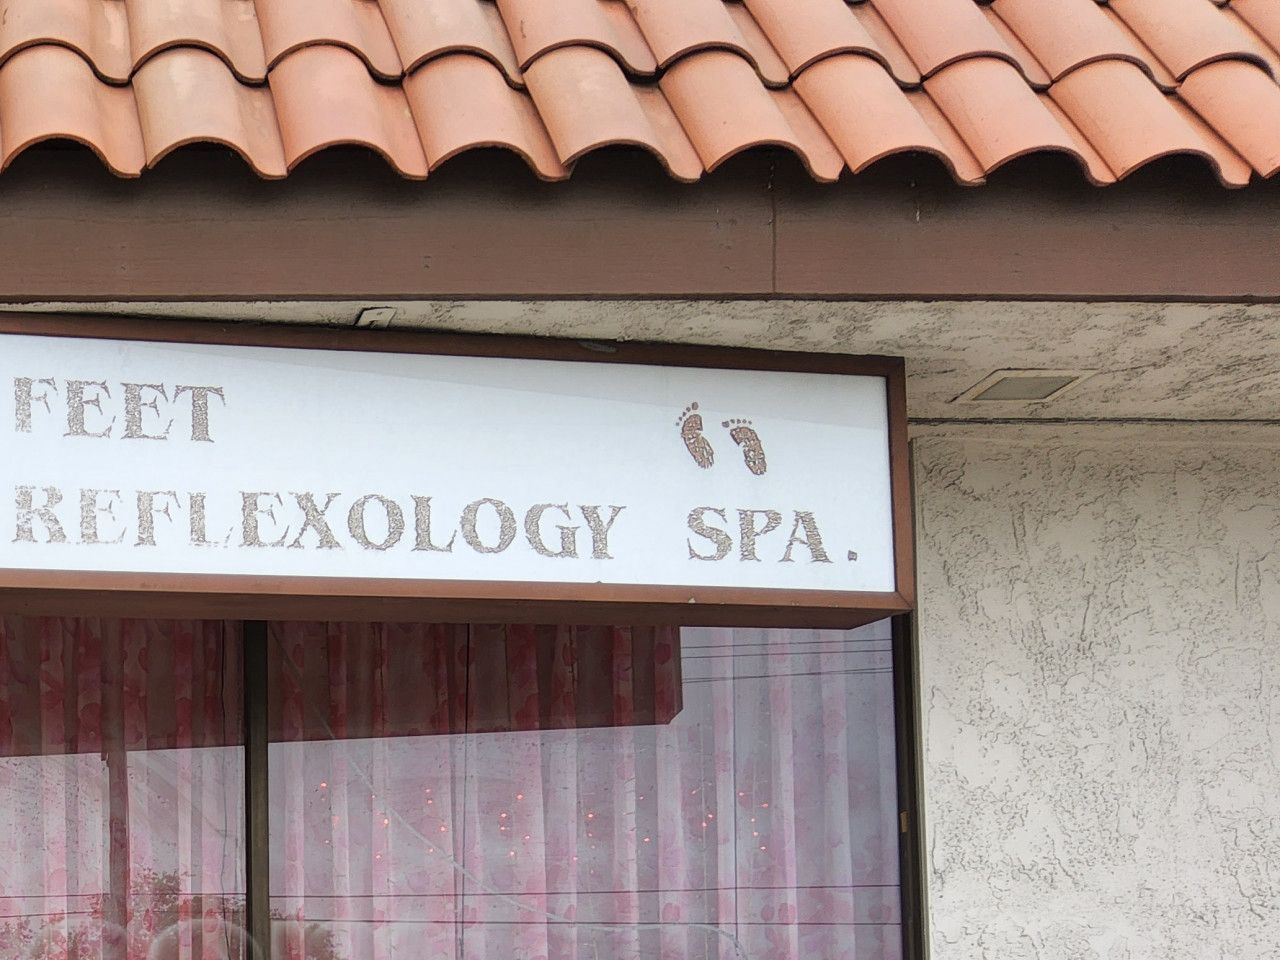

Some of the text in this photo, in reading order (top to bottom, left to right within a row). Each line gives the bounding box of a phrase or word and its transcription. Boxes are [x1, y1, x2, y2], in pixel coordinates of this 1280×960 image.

[13, 376, 226, 443] FEET
[11, 484, 858, 564] REFLEXOLOGY SPA.
